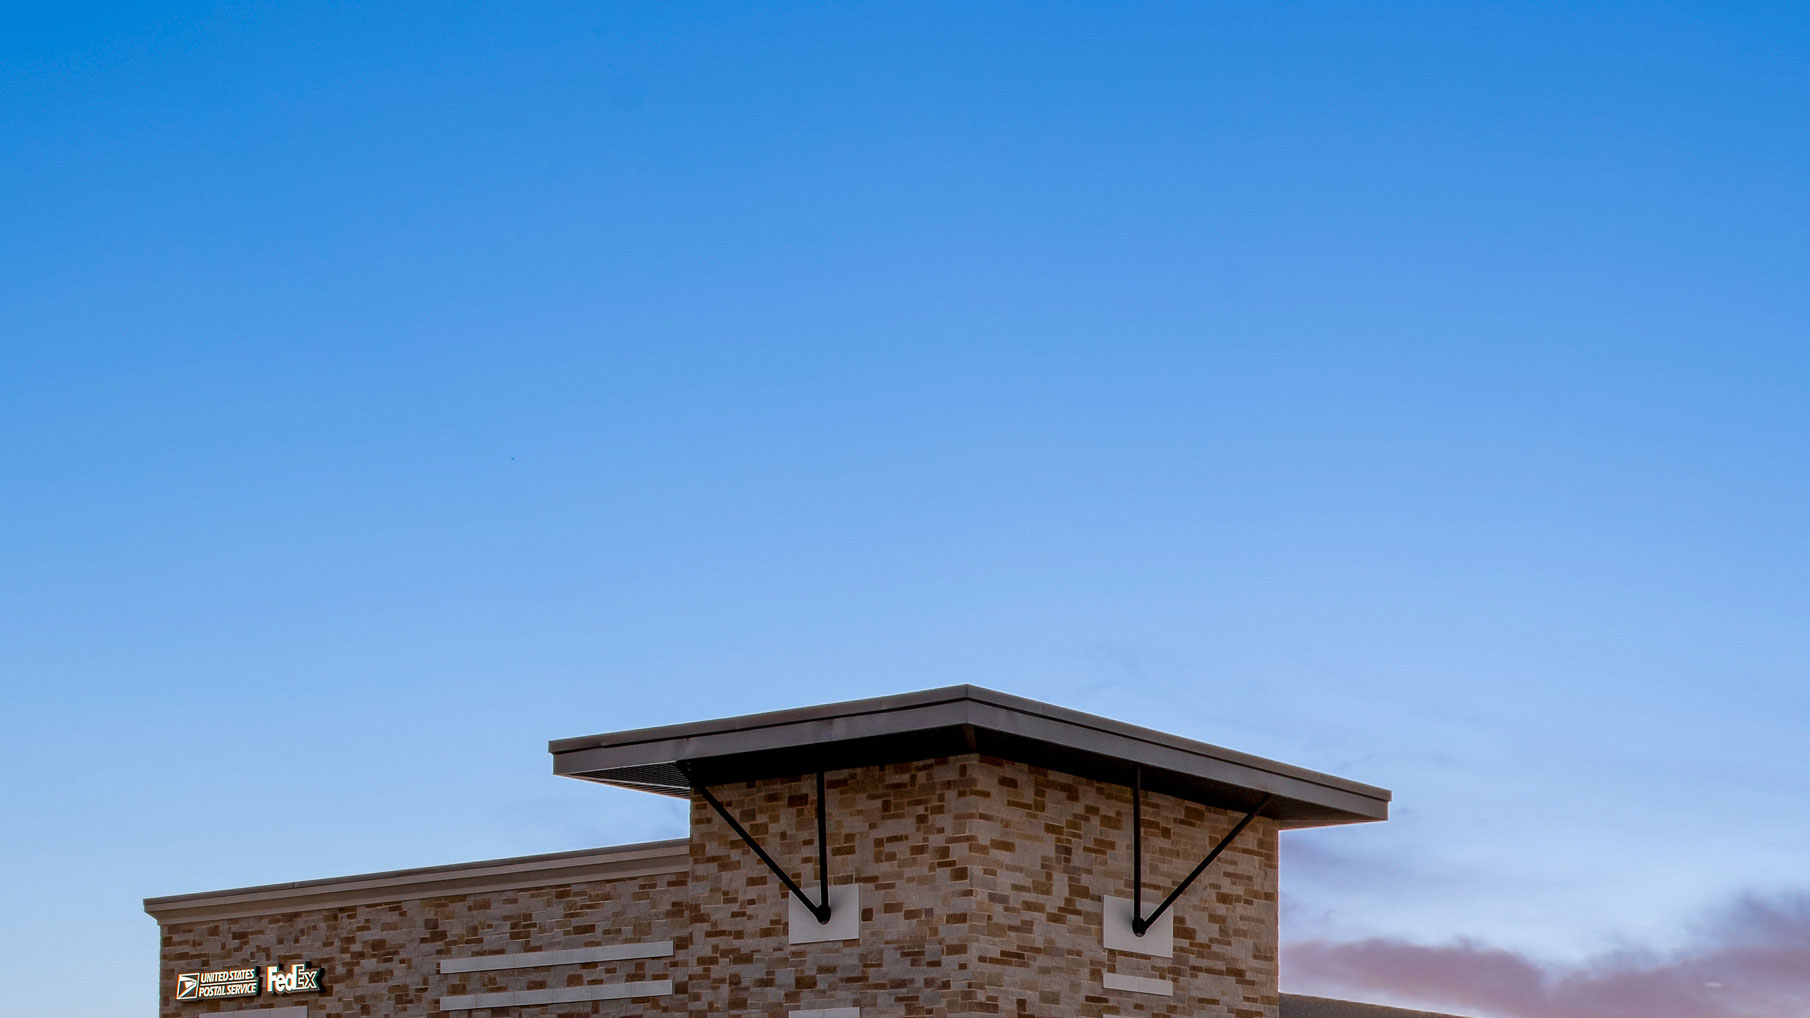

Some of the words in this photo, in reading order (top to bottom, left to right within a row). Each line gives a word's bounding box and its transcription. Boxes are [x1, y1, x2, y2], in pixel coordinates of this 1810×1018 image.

[200, 971, 229, 983] UNITED
[229, 968, 255, 980] STATES
[267, 963, 318, 992] FedEx
[198, 984, 227, 997] POSTAL
[227, 983, 257, 995] SERVICE
